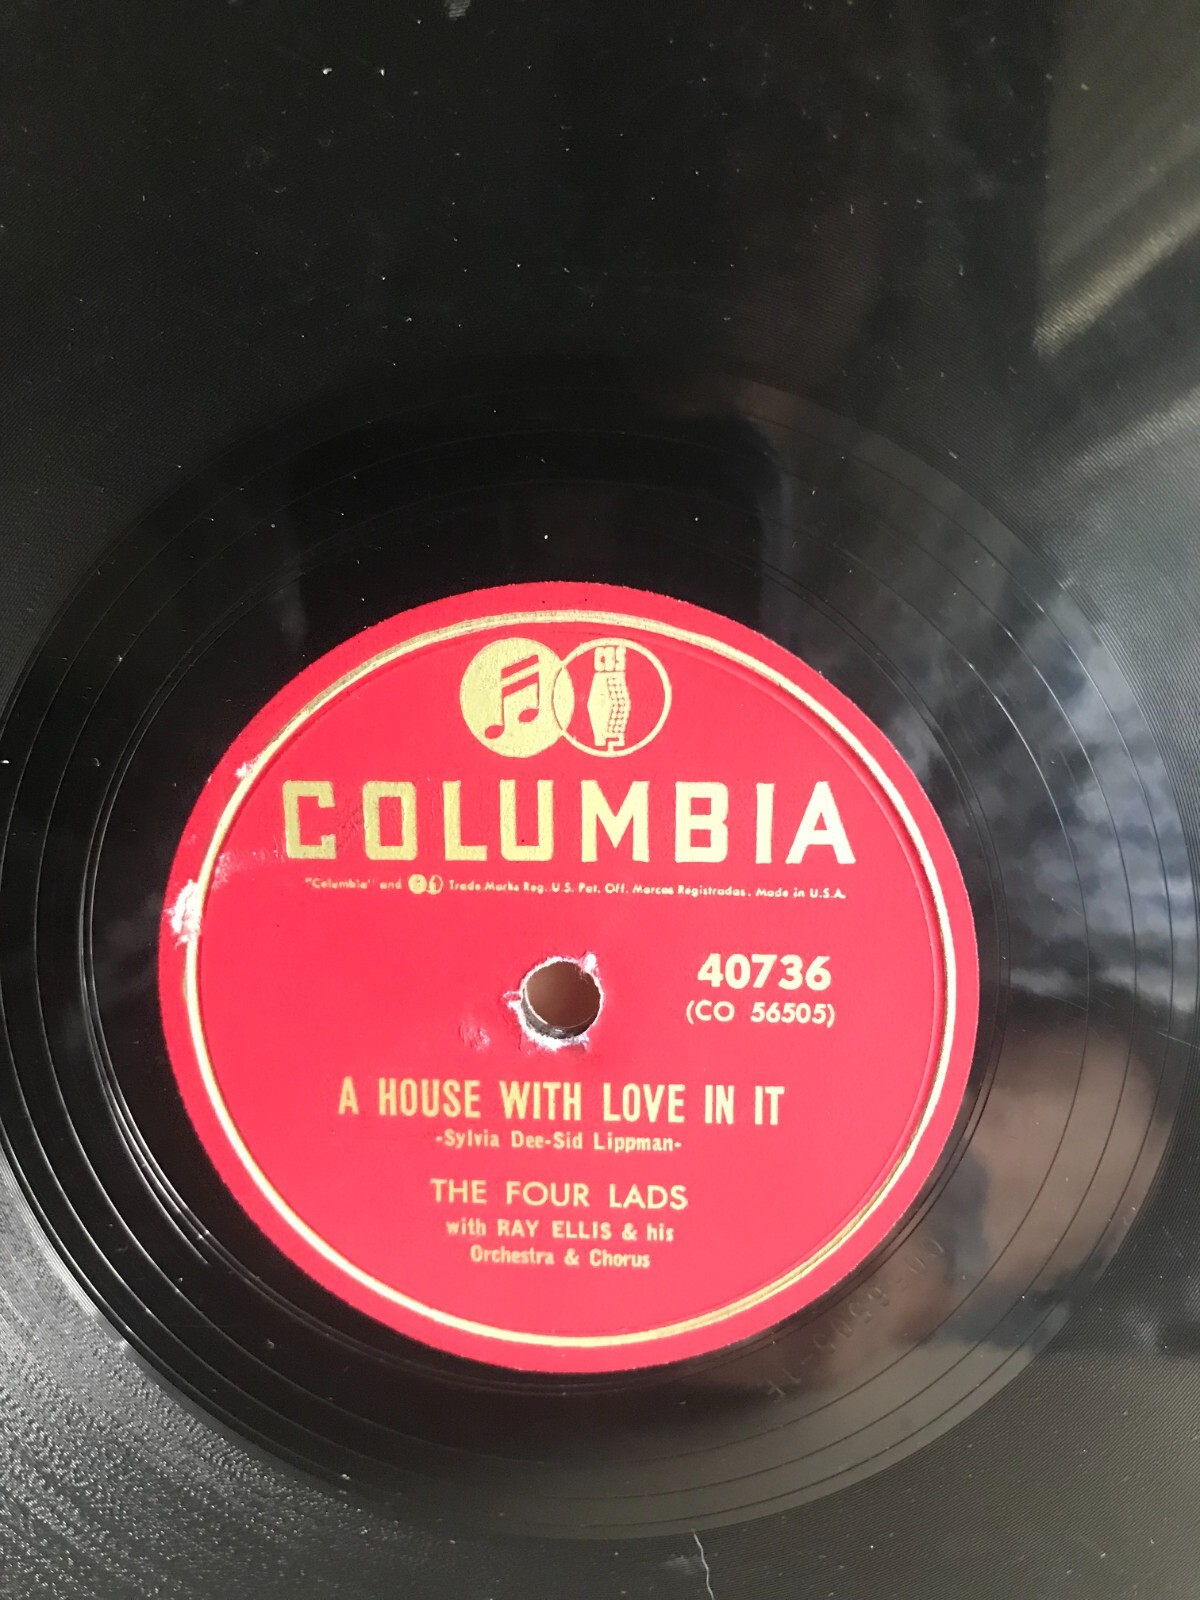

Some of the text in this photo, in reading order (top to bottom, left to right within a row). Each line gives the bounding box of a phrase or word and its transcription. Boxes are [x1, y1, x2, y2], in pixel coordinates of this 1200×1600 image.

[282, 779, 856, 864] COLUMBIA
[380, 879, 402, 889] and
[449, 880, 481, 891] Trade
[484, 881, 519, 891] Marks
[605, 883, 628, 894] Off.
[632, 884, 674, 895] Marcas
[756, 887, 788, 897] Made
[793, 887, 805, 897] in
[698, 953, 831, 991] 40736
[686, 999, 835, 1028] (CO 56505)
[339, 1076, 785, 1125] A HOUSE WITH LOVE IN IT
[436, 1129, 681, 1153] -Sylvia Dee-Sid Lippman-
[430, 1178, 688, 1210] THE FOUR LADS
[446, 1218, 673, 1242] with RAY ELLIS & his
[470, 1244, 650, 1268] Orchestra & Chorus
